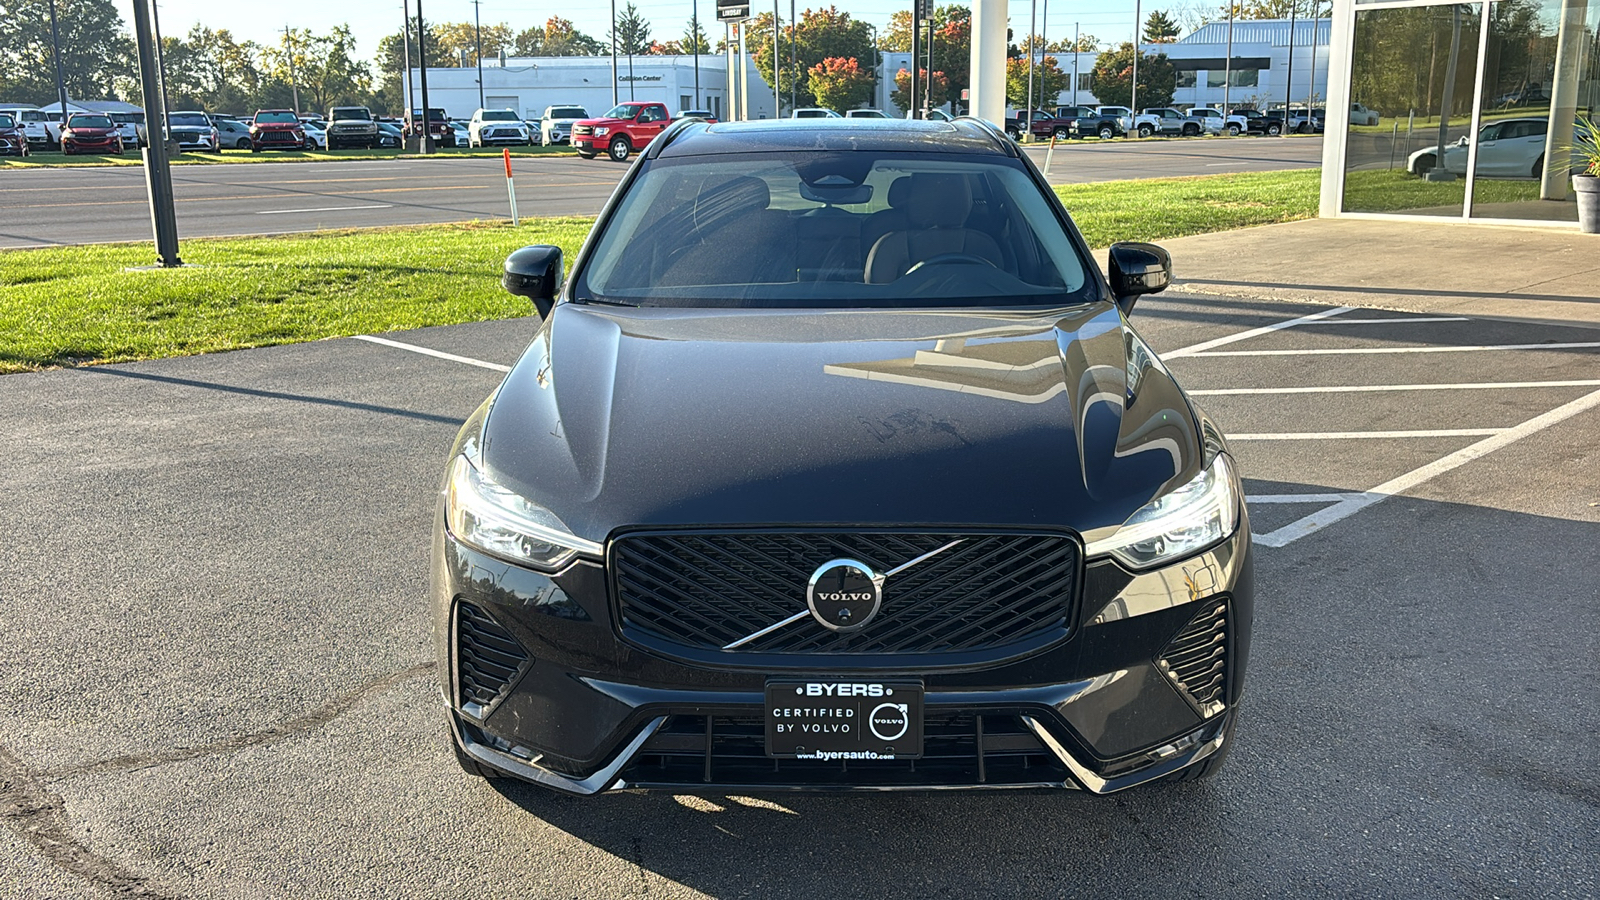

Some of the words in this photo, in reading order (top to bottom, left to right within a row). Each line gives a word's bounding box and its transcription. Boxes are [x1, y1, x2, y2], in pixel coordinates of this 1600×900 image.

[817, 592, 872, 601] VOLVO
[806, 683, 884, 697] BYERS
[772, 708, 854, 718] CERTIFIED
[777, 723, 795, 733] BY
[802, 723, 850, 733] VOLVO
[796, 750, 895, 762] www.byersauto.com
